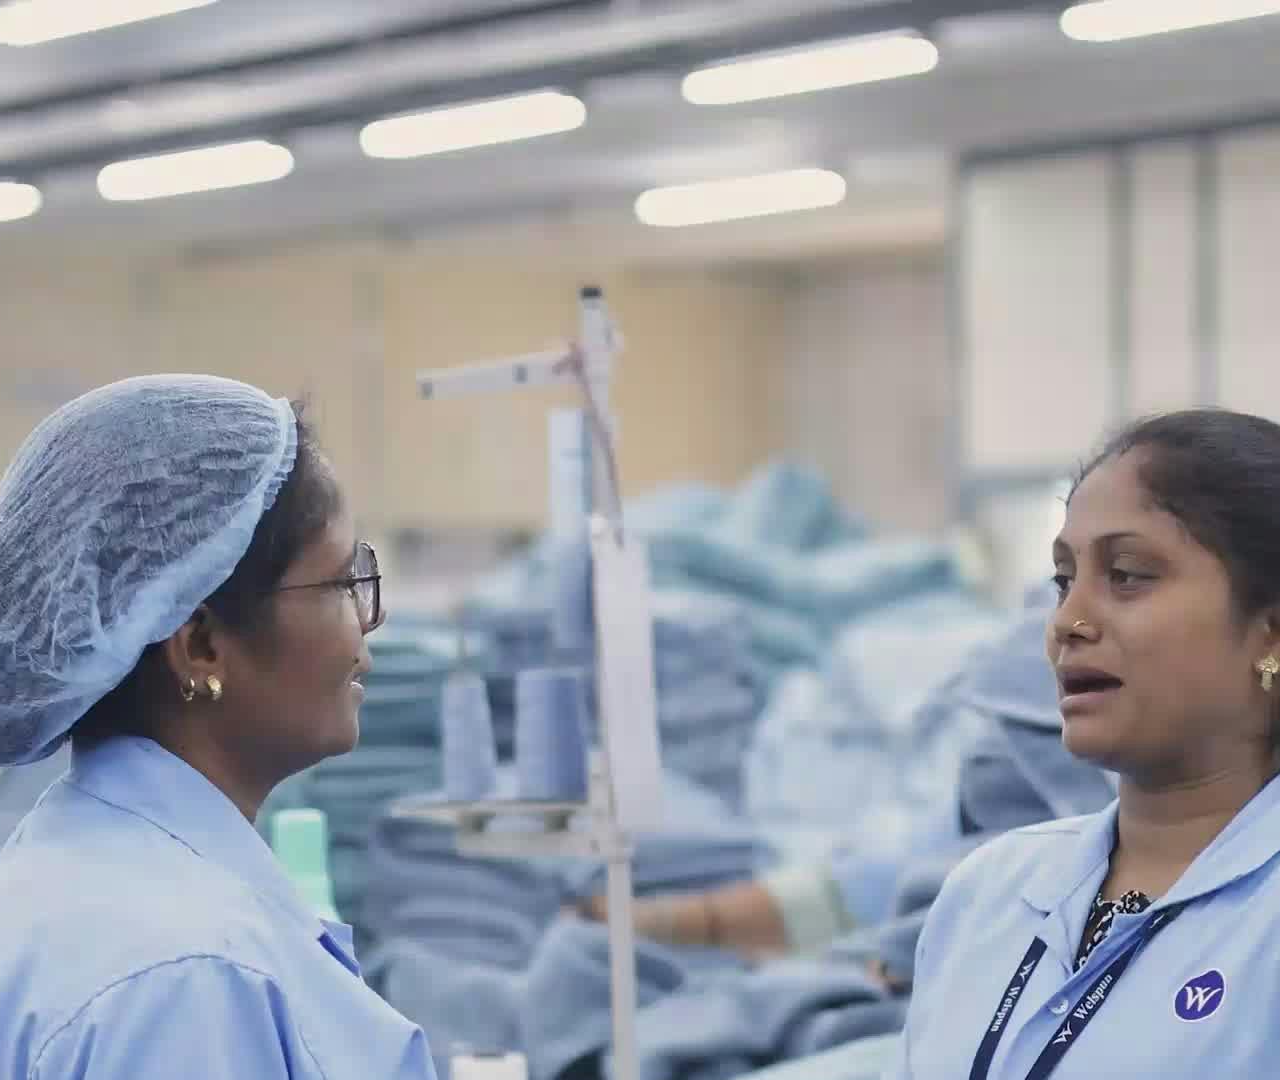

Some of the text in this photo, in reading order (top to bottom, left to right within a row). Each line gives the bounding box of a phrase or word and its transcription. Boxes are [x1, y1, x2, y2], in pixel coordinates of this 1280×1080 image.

[990, 986, 1021, 1032] Welspun
[1073, 973, 1113, 1020] Welspun
[1184, 986, 1222, 1012] W
